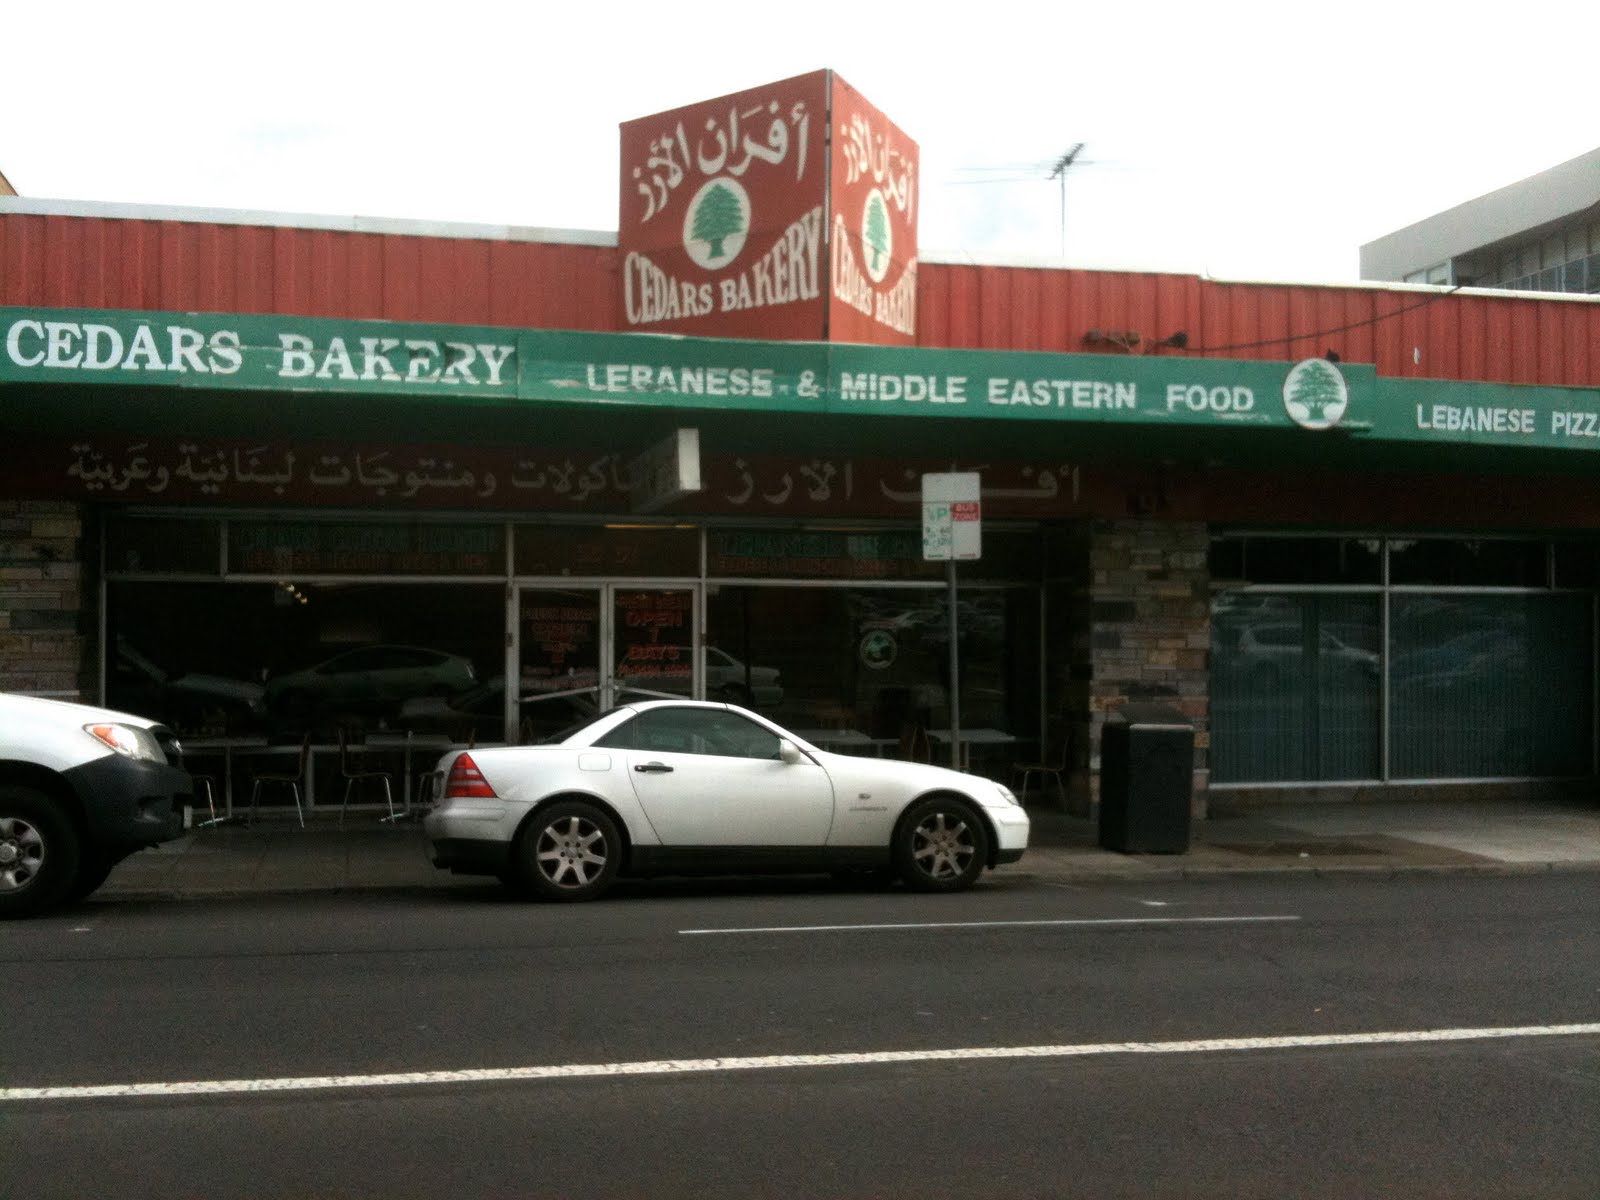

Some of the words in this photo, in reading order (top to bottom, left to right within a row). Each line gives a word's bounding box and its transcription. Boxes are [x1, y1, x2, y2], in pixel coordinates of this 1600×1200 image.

[624, 252, 714, 324] CEDARS
[720, 206, 822, 312] BAKERY
[6, 319, 243, 375] CEDARS
[278, 333, 515, 385] BAKERY
[586, 364, 773, 398] LEBANESE
[796, 370, 819, 398] &
[840, 372, 967, 403] MIDDLE
[988, 378, 1137, 410] EASTERN
[1166, 384, 1255, 412] FOOD
[1416, 403, 1536, 434] LEBANESE
[1551, 411, 1600, 438] PIZZ
